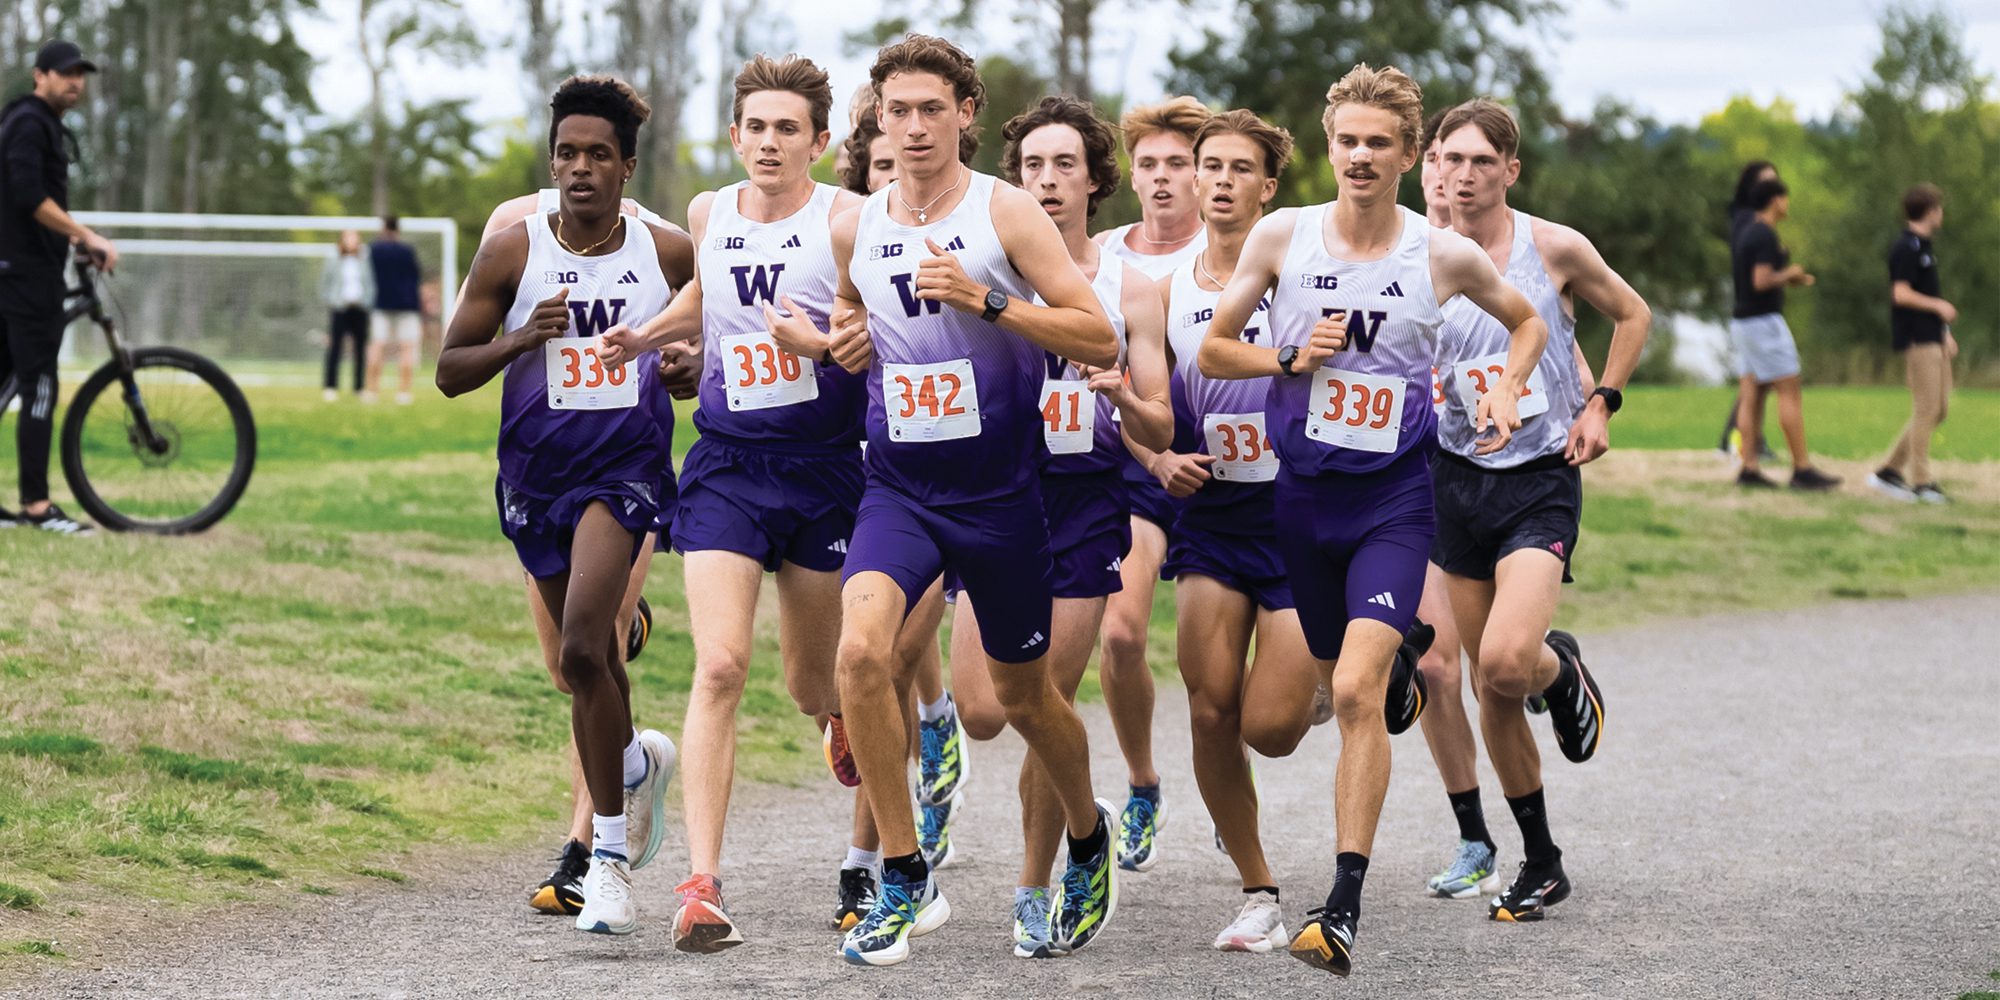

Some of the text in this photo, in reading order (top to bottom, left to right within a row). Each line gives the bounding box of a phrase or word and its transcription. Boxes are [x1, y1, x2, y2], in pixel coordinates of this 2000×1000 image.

[730, 263, 785, 307] W
[568, 298, 626, 338] W
[1321, 307, 1388, 354] W
[733, 343, 802, 388] 336
[894, 373, 966, 418] 342
[1322, 379, 1394, 430] 339
